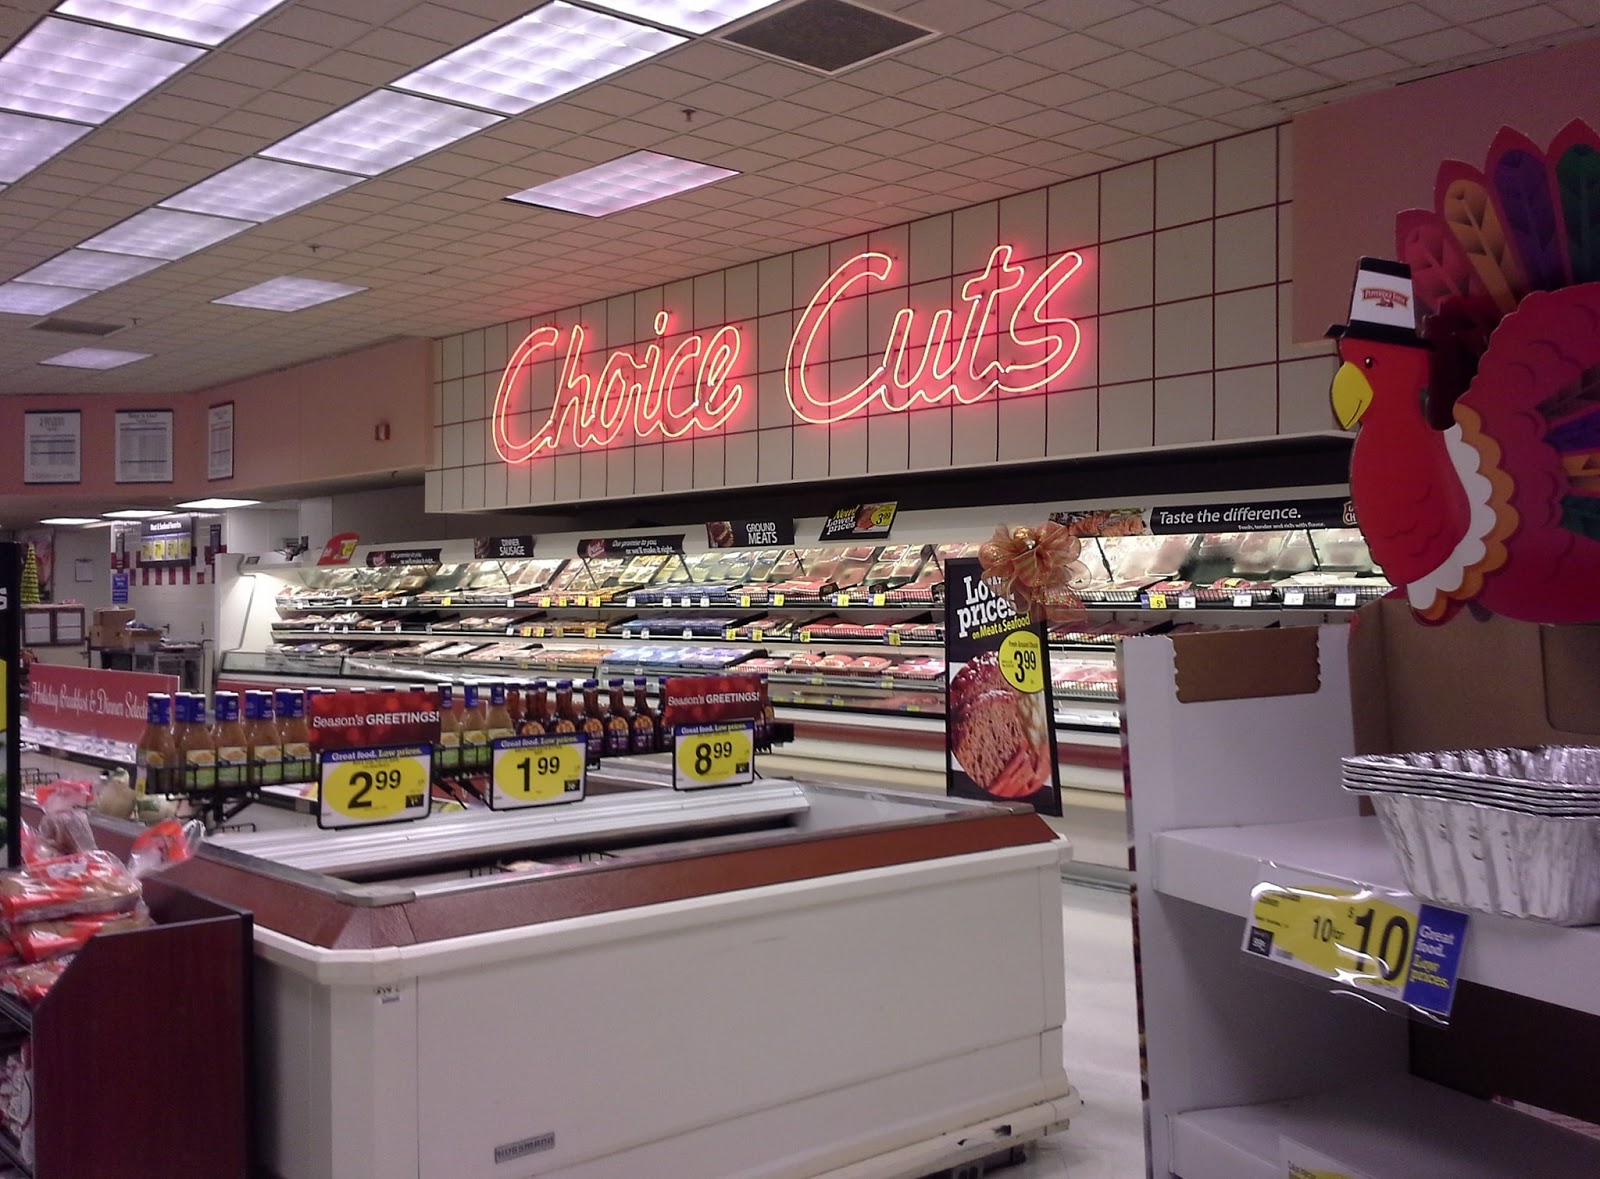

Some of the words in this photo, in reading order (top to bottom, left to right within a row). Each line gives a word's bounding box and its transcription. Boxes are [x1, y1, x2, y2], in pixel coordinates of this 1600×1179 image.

[492, 311, 743, 463] Choice
[785, 244, 1082, 423] Cuts
[826, 515, 855, 528] Lower
[1160, 511, 1194, 525] Taste
[1197, 508, 1220, 523] the
[1223, 506, 1301, 522] difference.
[746, 522, 776, 532] GROUND
[826, 521, 856, 536] prices
[748, 531, 778, 545] MEATS
[500, 546, 525, 556] SAUSAGE
[972, 631, 980, 640] on
[980, 623, 998, 638] Meat
[1002, 611, 1031, 632] Seafood
[667, 694, 705, 706] Season's
[706, 691, 759, 704] GREETINGS!
[313, 714, 365, 728] Season's
[366, 710, 439, 726] GREETINGS!
[681, 725, 699, 735] Great
[500, 739, 521, 748] Great
[331, 752, 356, 761] Great
[378, 749, 396, 758] Low
[1419, 924, 1455, 945] Great
[1412, 953, 1440, 973] Low
